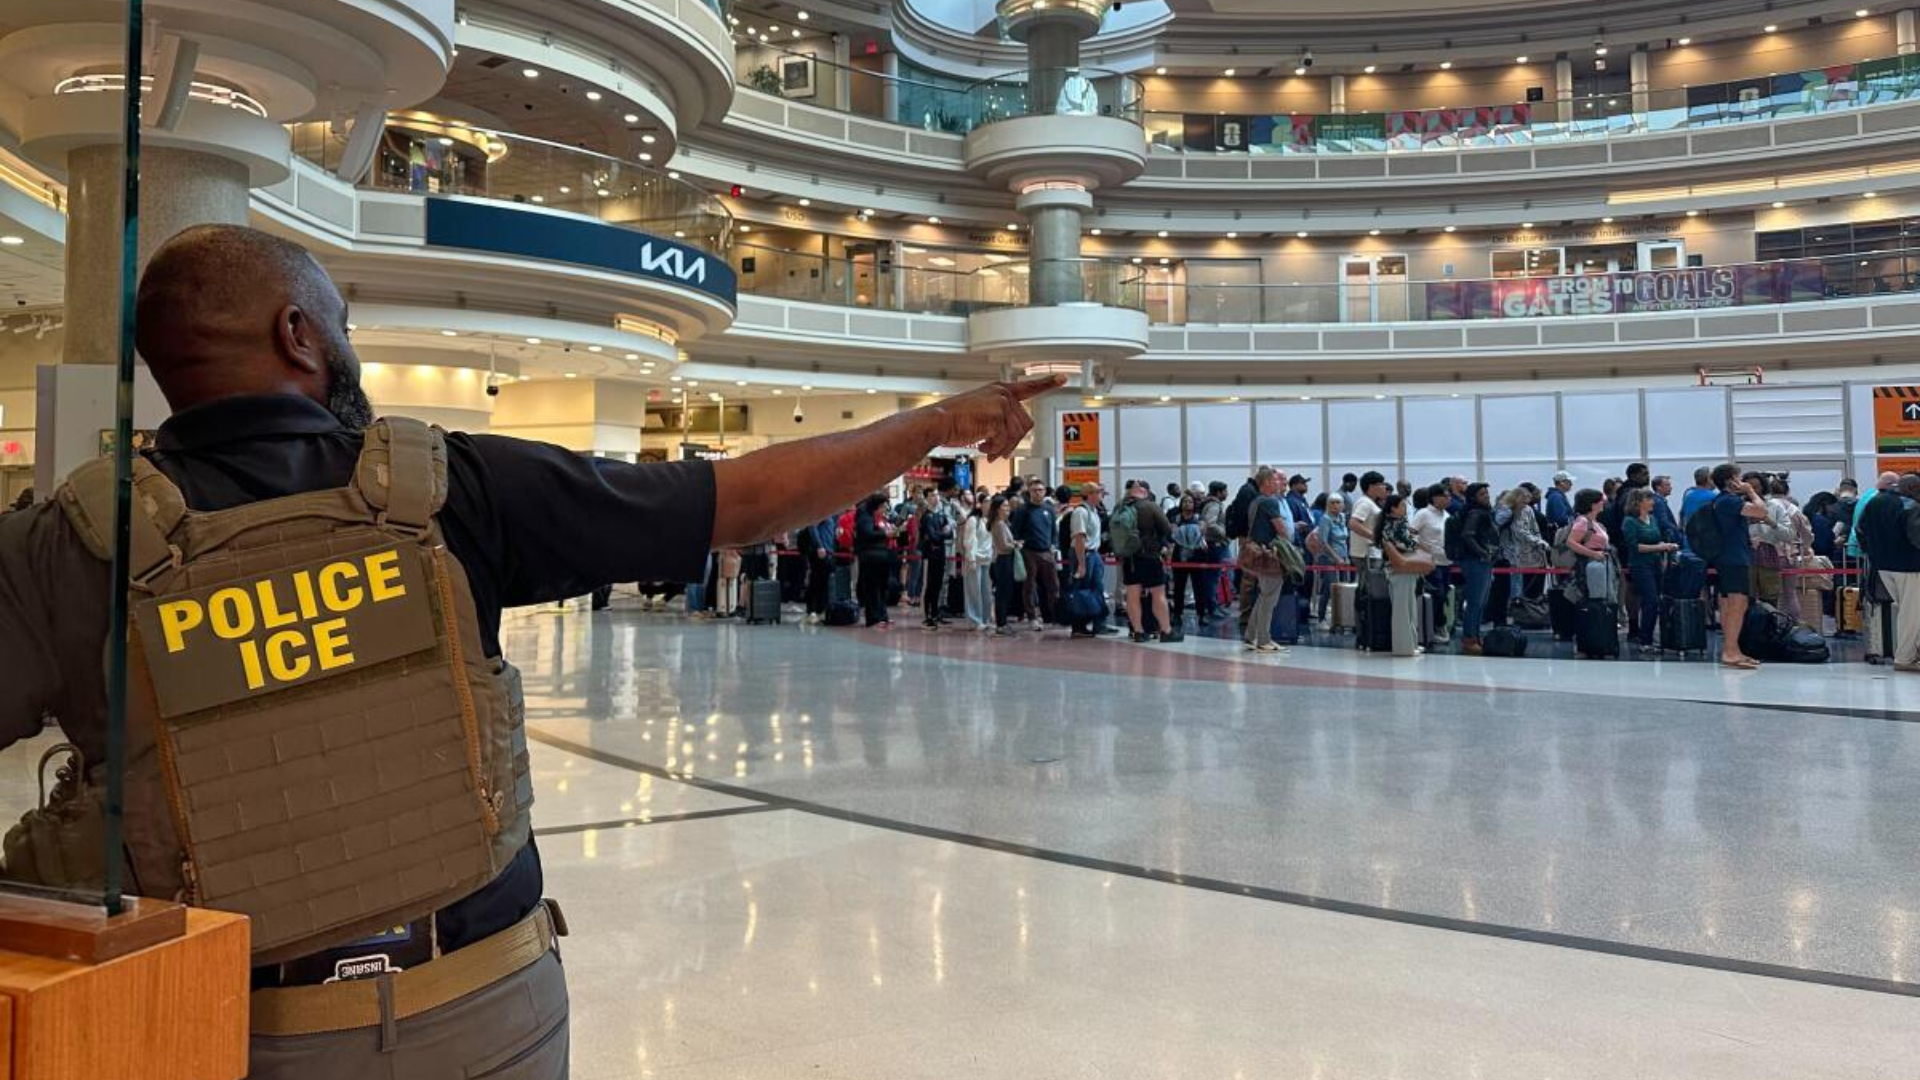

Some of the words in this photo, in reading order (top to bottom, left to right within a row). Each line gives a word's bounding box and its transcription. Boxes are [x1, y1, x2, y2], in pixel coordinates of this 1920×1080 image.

[641, 241, 706, 284] KIA
[1549, 278, 1609, 294] FROM
[1615, 278, 1633, 294] TO
[1634, 269, 1736, 303] GOALS
[1504, 294, 1613, 317] GATES
[158, 550, 406, 653] POLICE
[239, 617, 355, 690] ICE
[341, 961, 383, 977] INSANE
